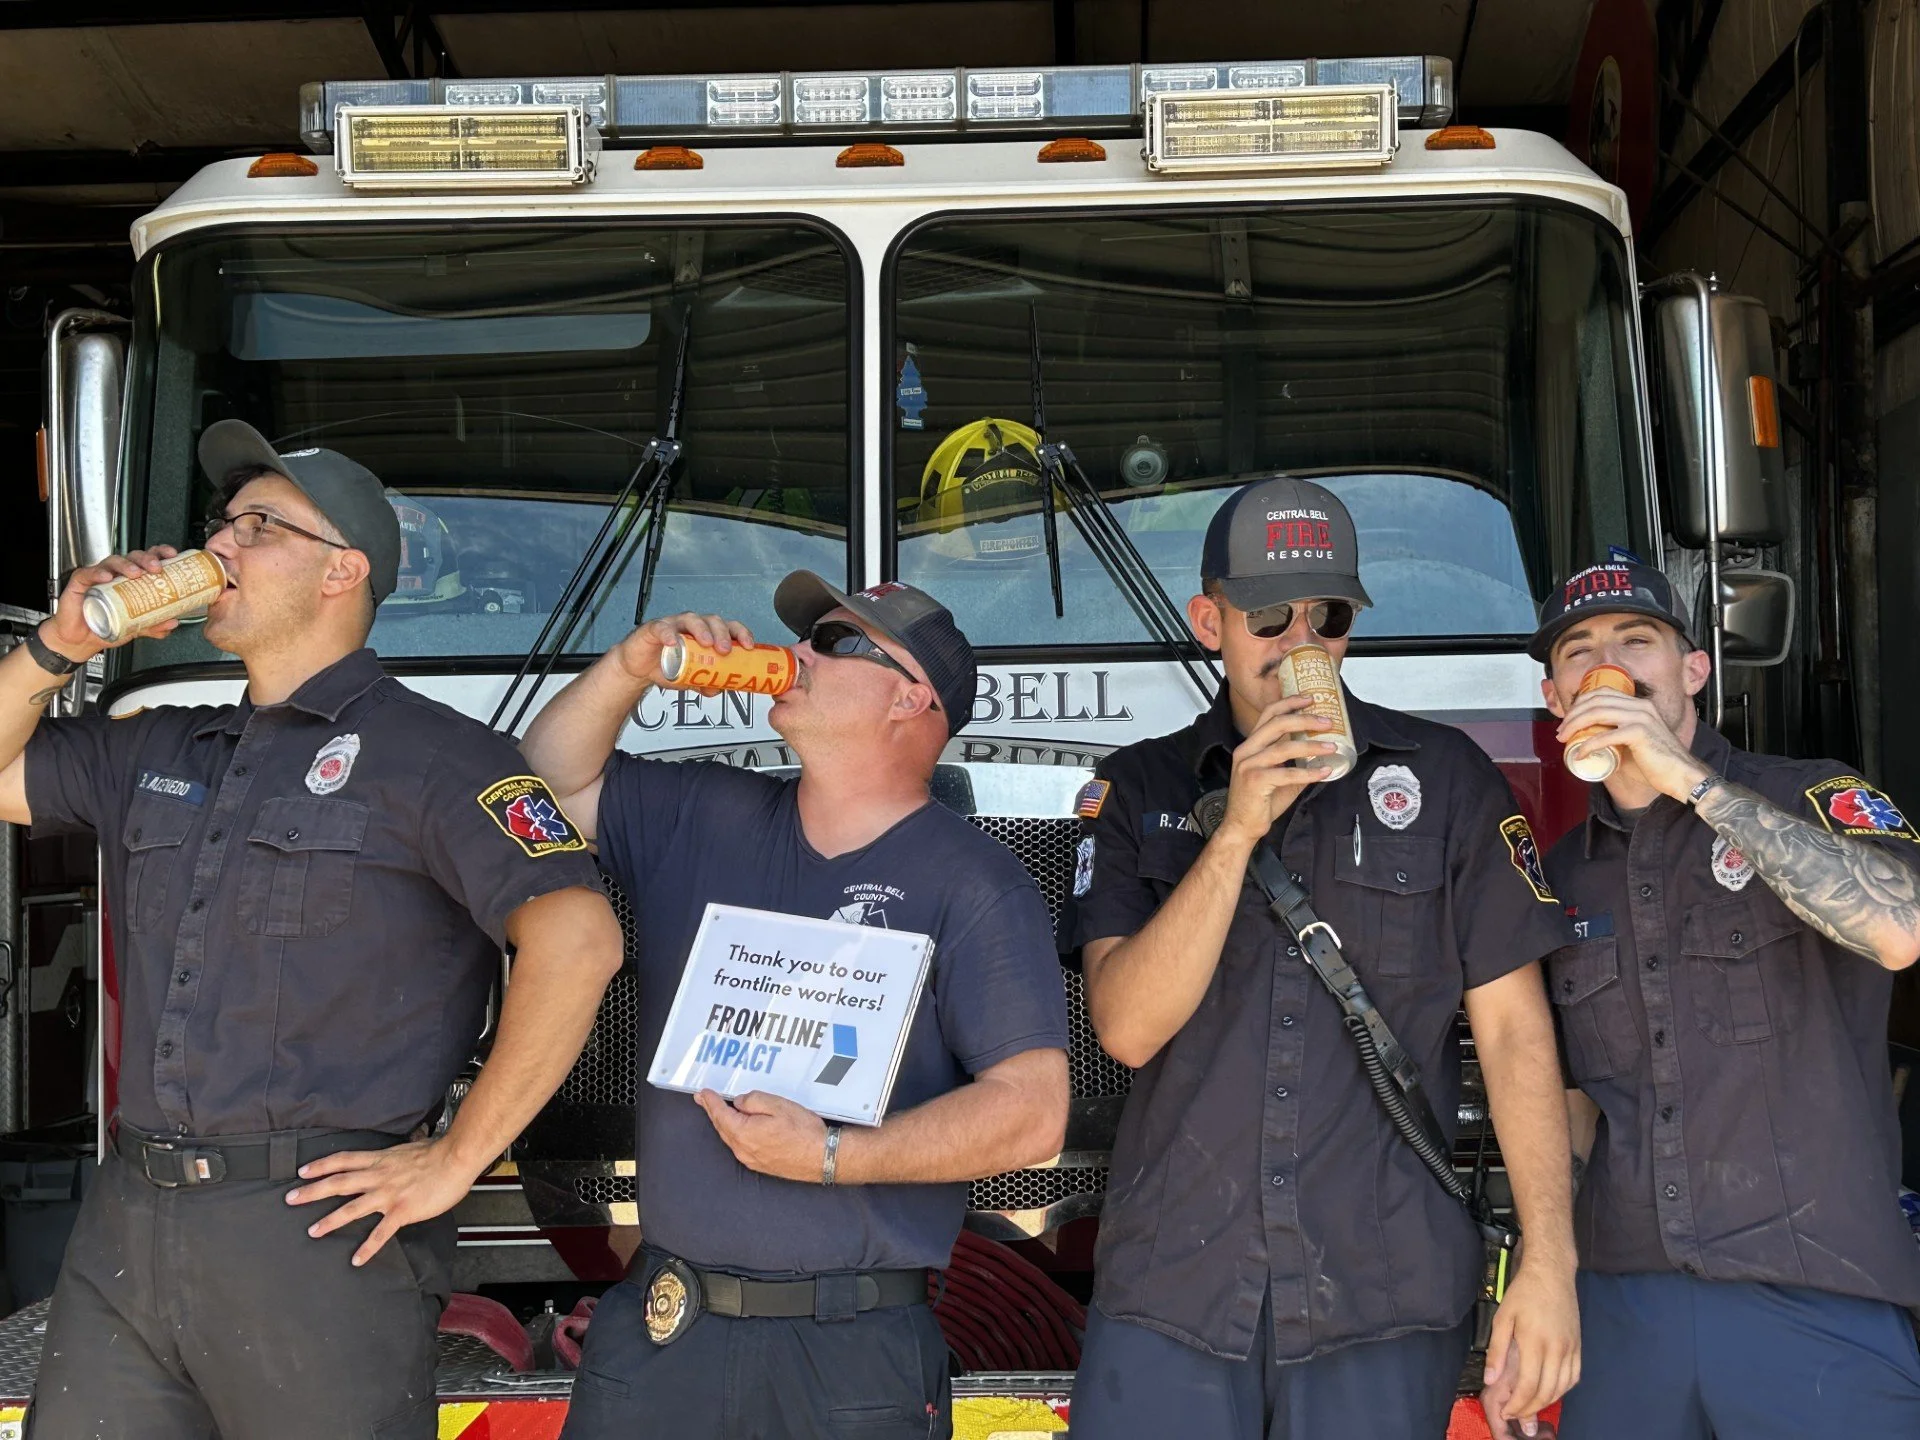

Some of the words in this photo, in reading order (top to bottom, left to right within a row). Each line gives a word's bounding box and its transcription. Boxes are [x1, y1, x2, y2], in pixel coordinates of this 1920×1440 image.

[1266, 509, 1309, 520] CENTRAL
[1309, 509, 1329, 520] BELL
[1266, 521, 1333, 548] FIRE
[1267, 550, 1333, 560] RESCUE
[178, 560, 200, 593] MATE
[1566, 565, 1604, 585] CENTRAL
[1564, 571, 1632, 605] FIRE
[1564, 590, 1632, 612] RESCUE
[689, 669, 783, 693] CLEAN
[1297, 668, 1332, 680] MATE
[969, 671, 1133, 724] BELL
[486, 782, 521, 804] CENTRAL
[503, 787, 534, 802] COUNTY
[1160, 813, 1172, 828] R.
[843, 883, 883, 894] CENTRAL
[884, 885, 905, 900] BELL
[853, 893, 890, 903] COUNTY
[1574, 921, 1589, 938] ST
[729, 944, 786, 968] Thank
[787, 959, 824, 974] you
[829, 962, 848, 978] to
[852, 968, 888, 984] our
[713, 968, 792, 996] frontline
[798, 987, 885, 1012] workers!
[705, 1003, 828, 1049] FRONTLINE
[695, 1034, 782, 1074] IMPACT
